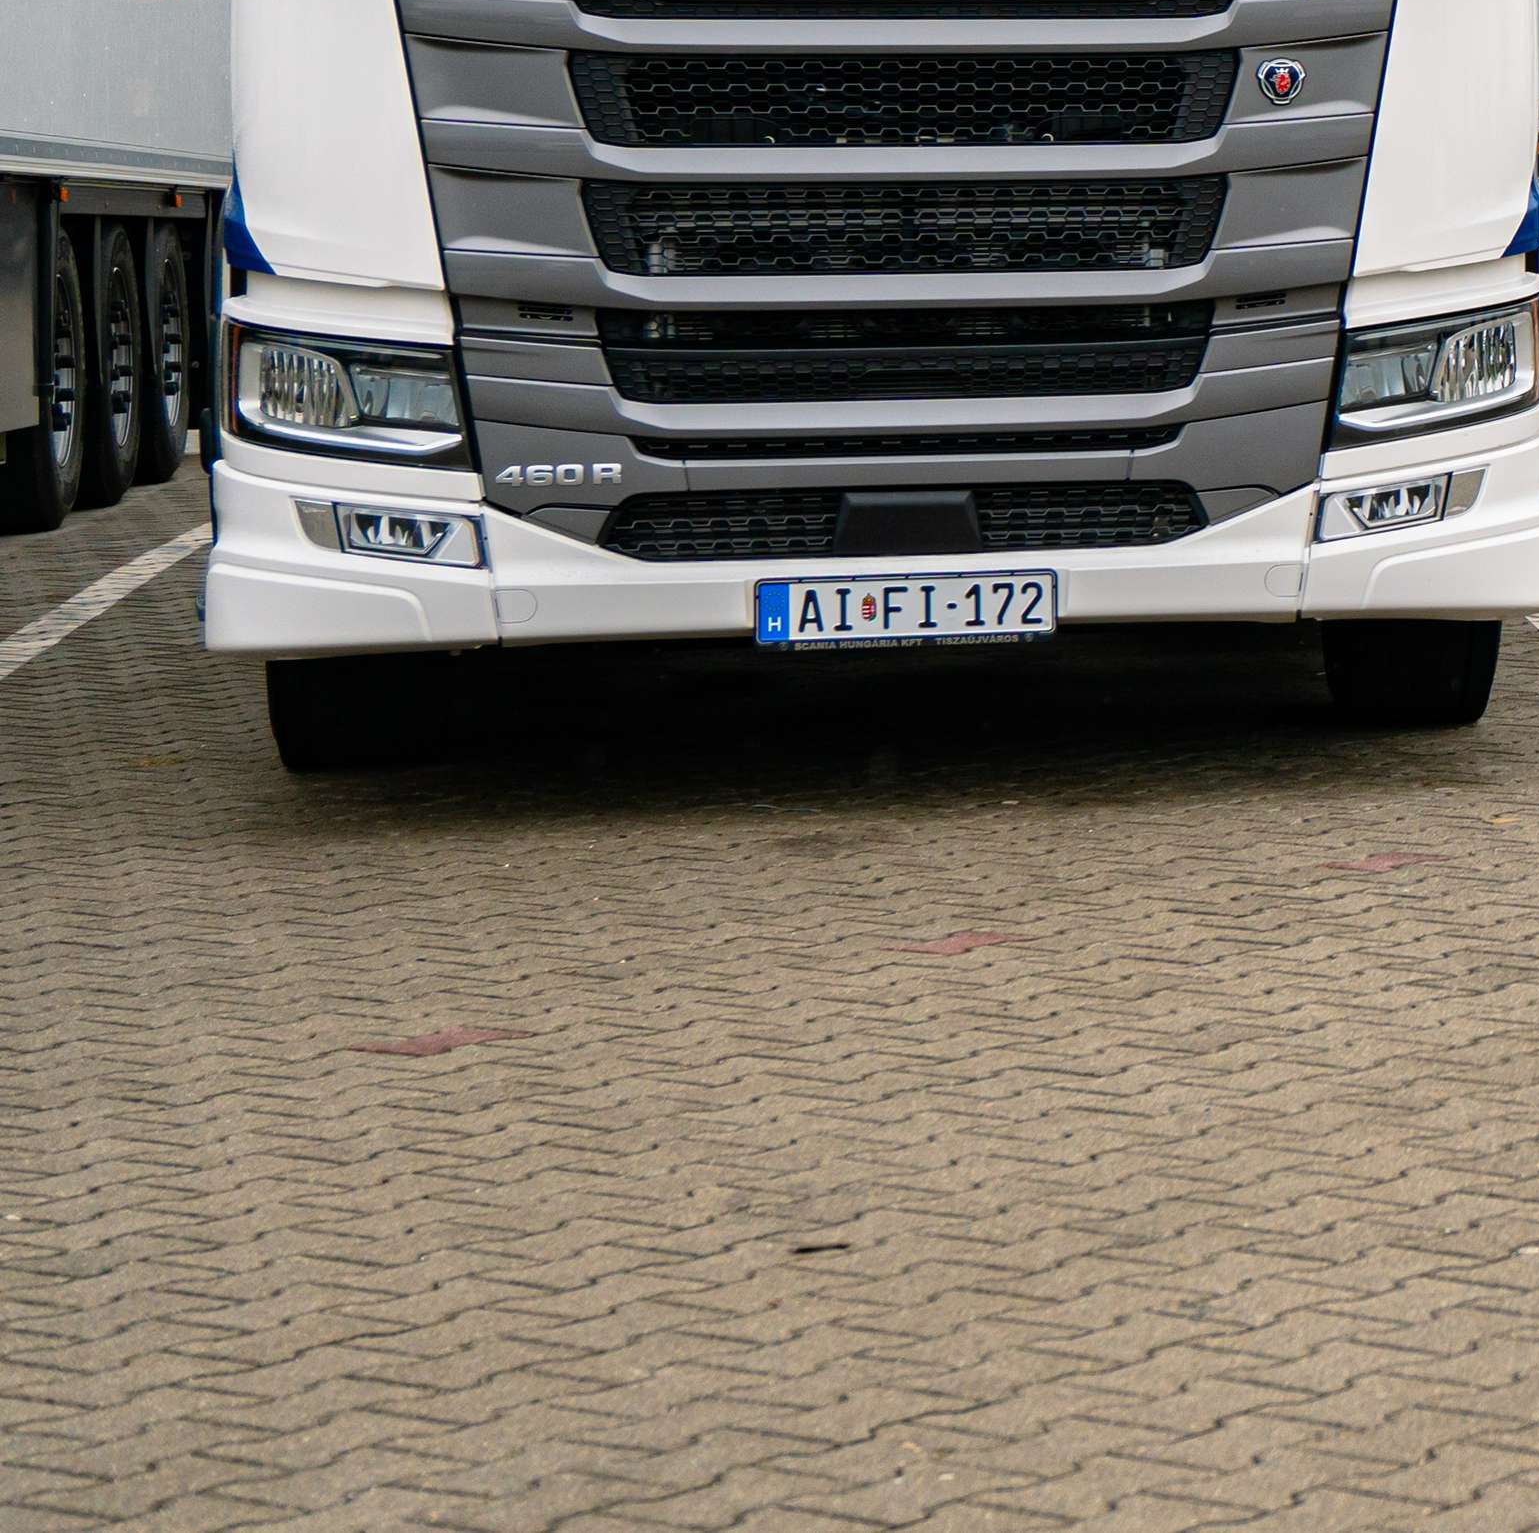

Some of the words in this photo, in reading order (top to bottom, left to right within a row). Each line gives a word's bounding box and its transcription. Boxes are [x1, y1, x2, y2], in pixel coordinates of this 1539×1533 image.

[495, 463, 585, 487] 460
[592, 462, 623, 486] R
[798, 588, 854, 632] AI
[883, 581, 1044, 629] FI-172
[767, 616, 782, 632] H
[794, 641, 837, 651] SCANIA
[900, 638, 923, 647] KFT
